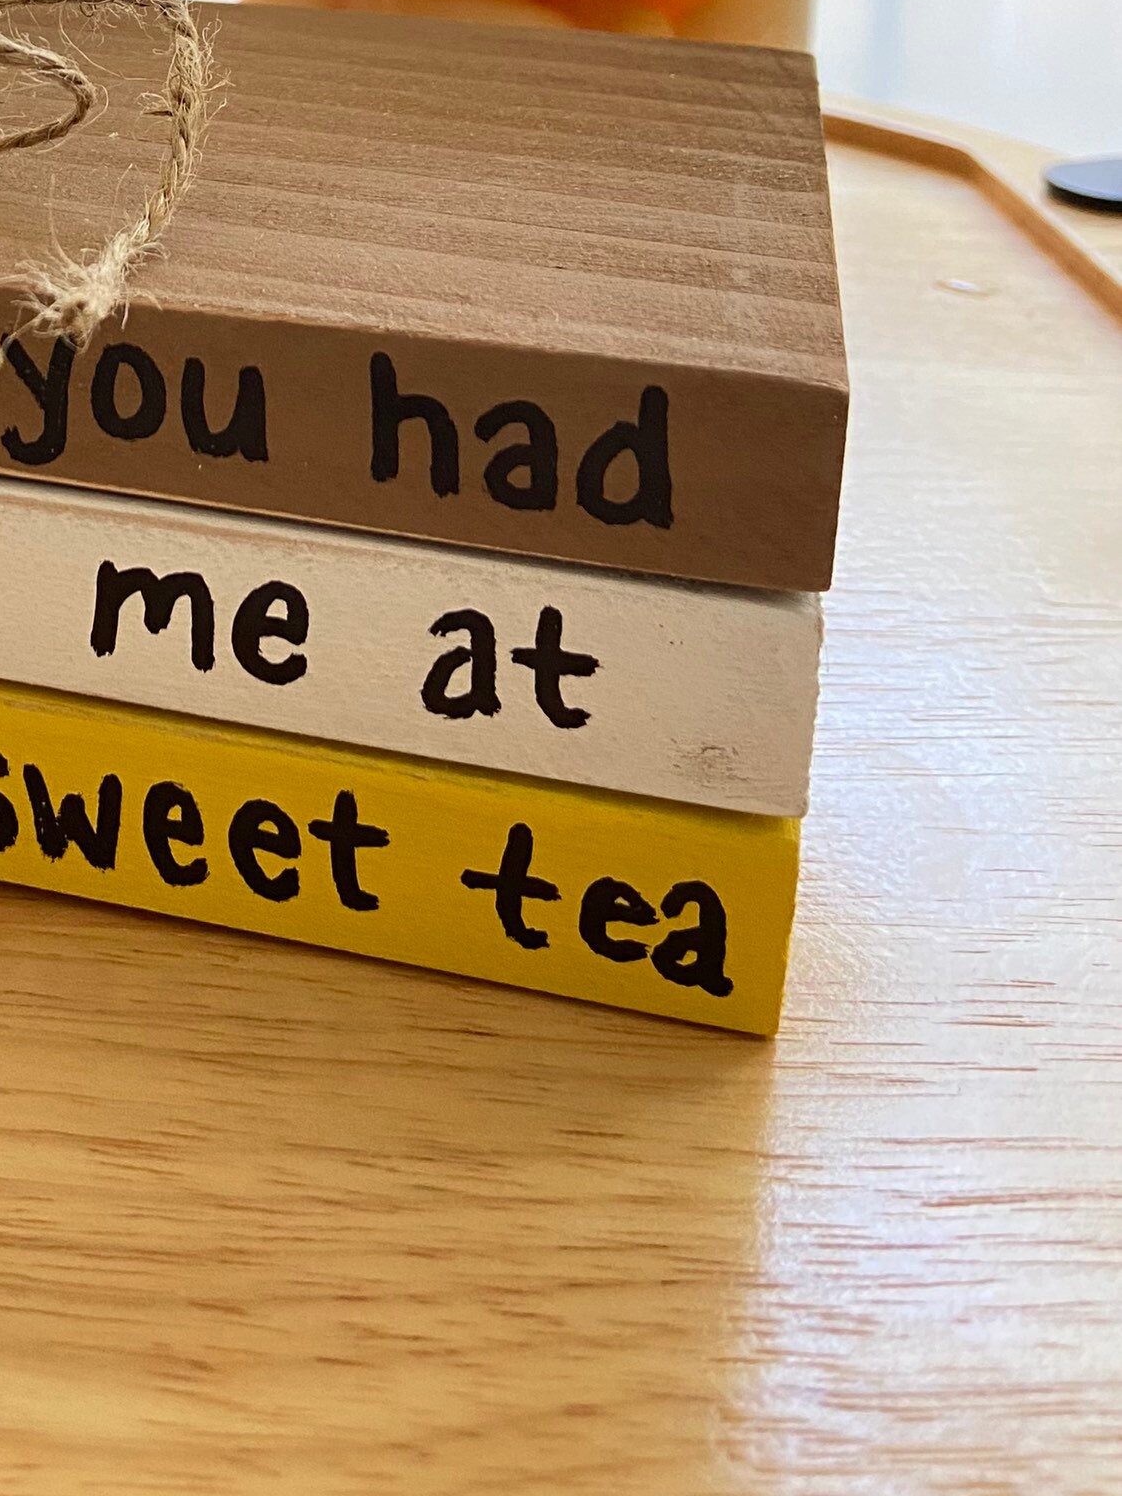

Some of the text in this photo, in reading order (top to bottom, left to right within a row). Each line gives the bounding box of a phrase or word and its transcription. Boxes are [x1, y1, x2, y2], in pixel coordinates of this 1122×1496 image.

[0, 332, 675, 531] you had
[89, 559, 603, 730] me at
[460, 822, 735, 998] tea
